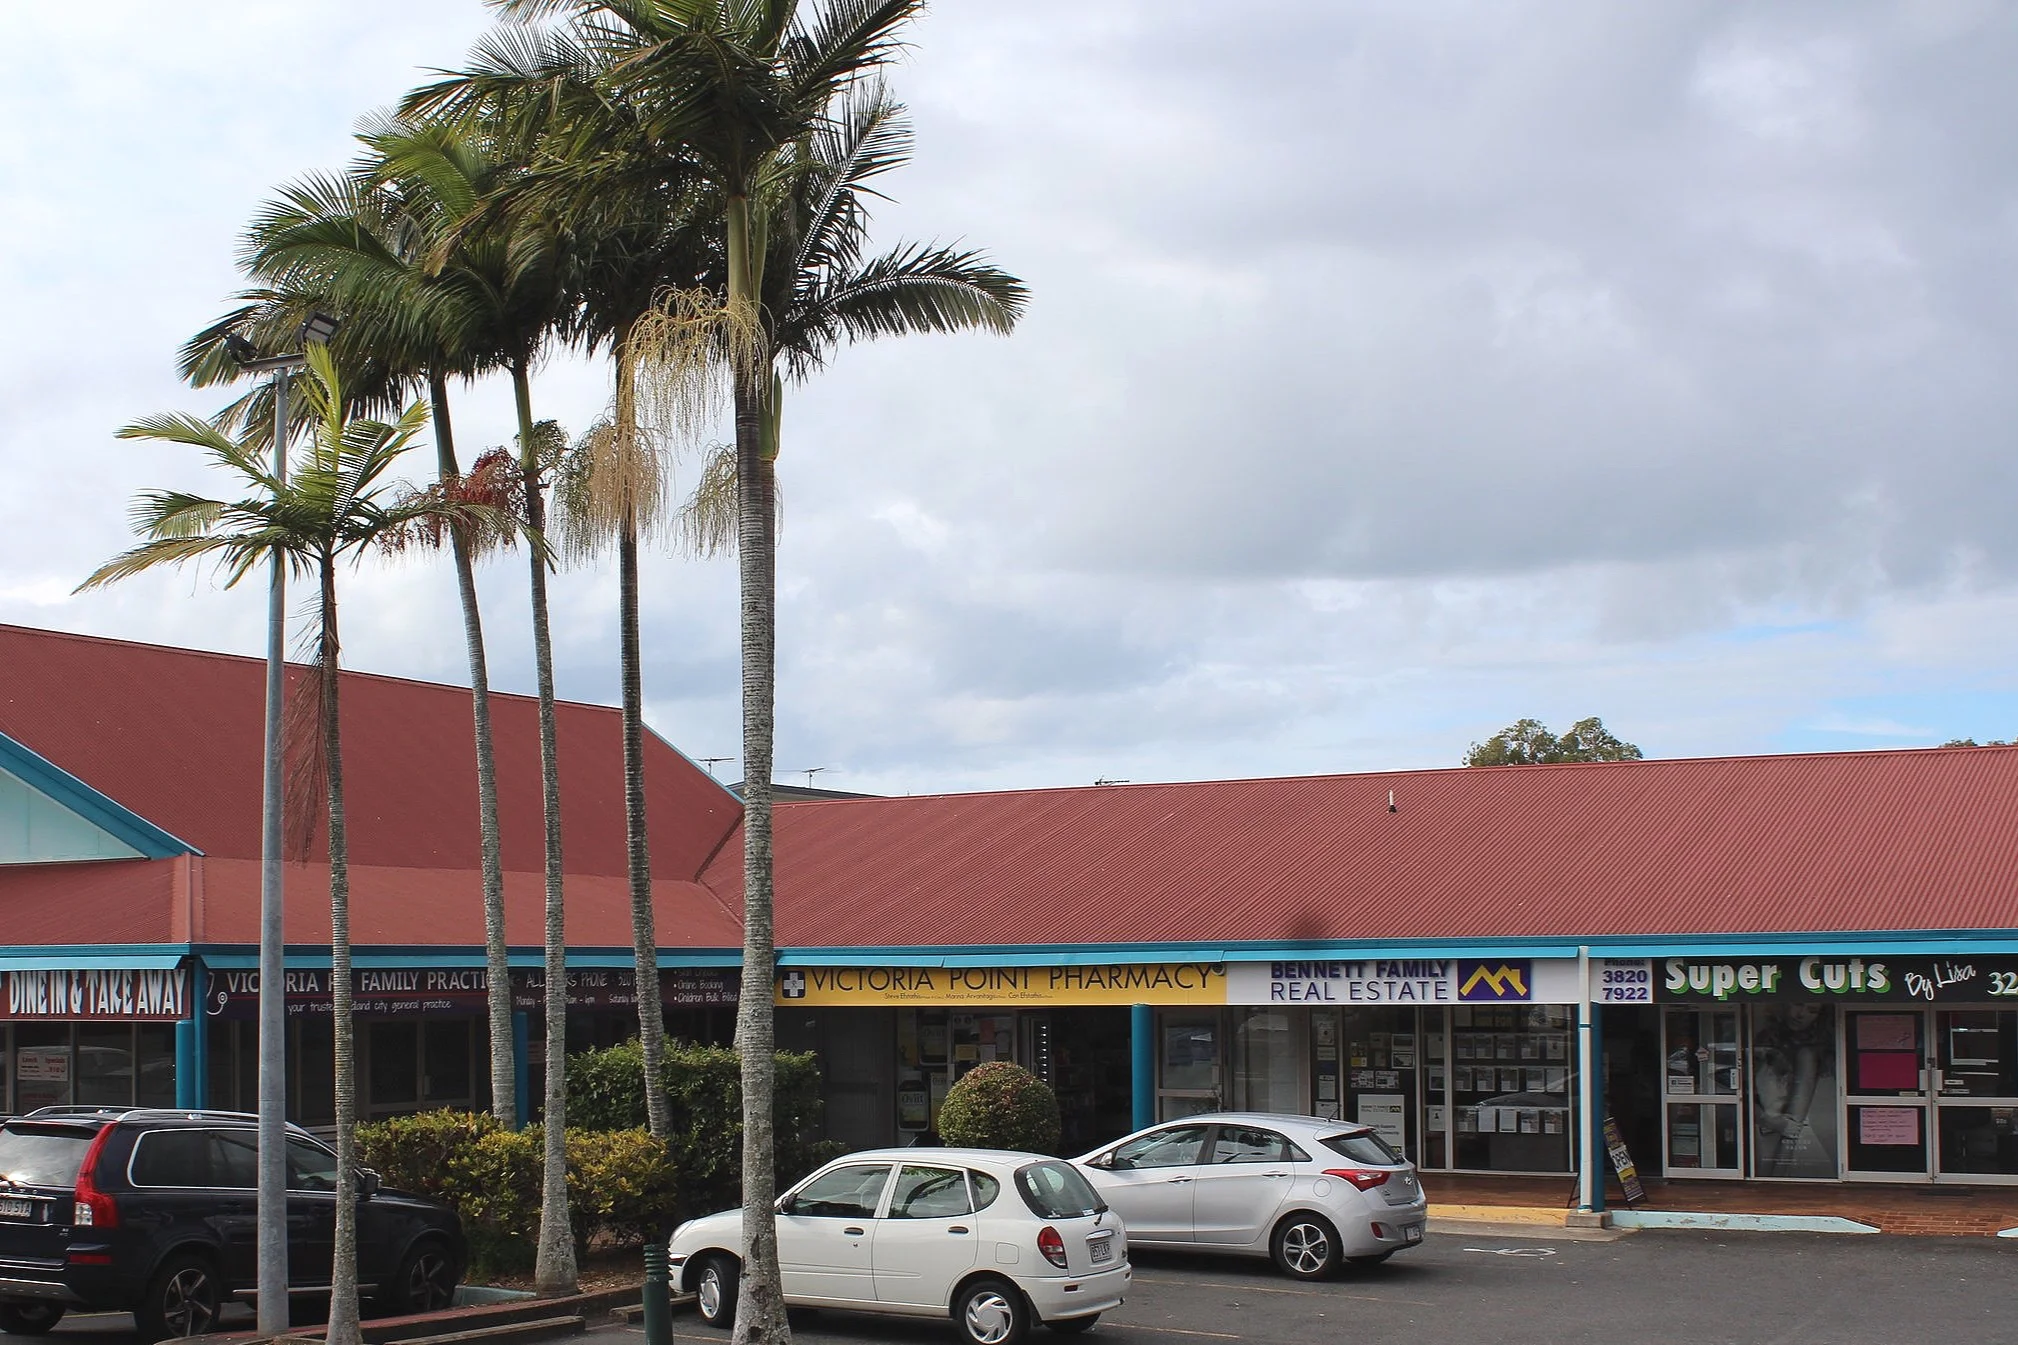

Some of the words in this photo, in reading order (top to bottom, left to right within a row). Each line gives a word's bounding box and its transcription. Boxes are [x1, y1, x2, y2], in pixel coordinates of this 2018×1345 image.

[810, 967, 935, 991] VICTORIA
[951, 966, 1030, 991] POINT
[1049, 963, 1214, 990] PHARMACY
[1270, 960, 1366, 979] BENNETT
[1376, 959, 1452, 978] FAMILY
[1602, 969, 1648, 983] 3820
[1665, 958, 1780, 1000] Super
[1799, 957, 1890, 994] Cuts
[1933, 960, 1977, 988] Lisa
[10, 971, 47, 1014] DINE
[50, 970, 67, 1014] IN
[86, 970, 134, 1014] TAKE
[137, 969, 187, 1014] AWAY
[227, 971, 320, 992] VICRIA
[361, 970, 419, 991] FAMILY
[427, 970, 488, 990] PRACTI
[1271, 981, 1336, 1001] REAL
[1350, 980, 1449, 1001] ESTATE
[1602, 987, 1648, 1001] 7922
[310, 1002, 335, 1012] truste
